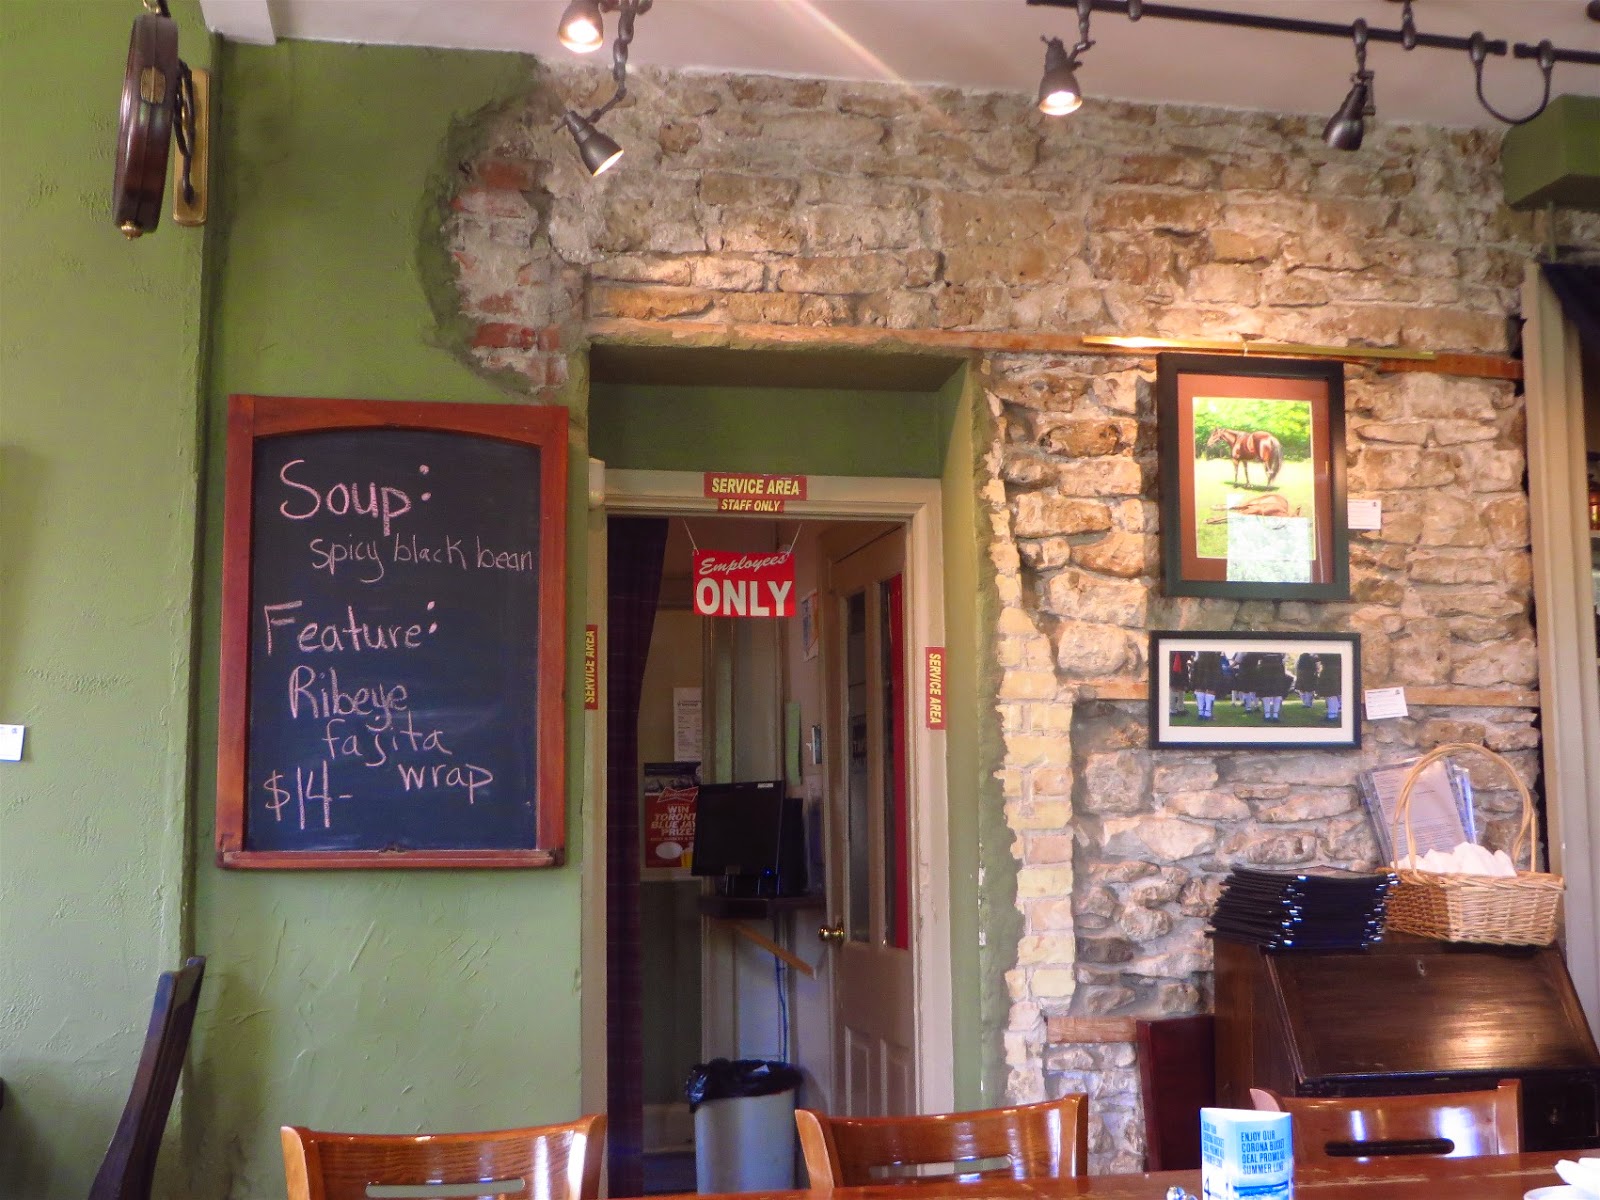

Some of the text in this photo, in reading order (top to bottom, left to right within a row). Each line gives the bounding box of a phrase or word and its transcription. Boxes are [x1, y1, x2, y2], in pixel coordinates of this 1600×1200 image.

[279, 458, 433, 536] Soup:
[711, 477, 800, 496] SERVICE AREA
[721, 498, 780, 512] STAFF ONLY
[393, 533, 469, 570] black
[476, 535, 534, 572] bean
[698, 553, 788, 576] Employees
[696, 577, 793, 617] ONLY
[263, 600, 439, 656] Feature:
[585, 630, 596, 704] SERVICE AREA
[287, 665, 408, 730] Ribeye
[929, 653, 942, 724] SERVICE AREA
[321, 711, 453, 767] fajita
[397, 763, 494, 804] wrap
[654, 813, 696, 821] TORONT
[668, 805, 690, 813] WIN
[650, 820, 679, 829] BLUE
[661, 828, 695, 836] PRIZE
[1241, 1129, 1276, 1142] ENJOY OUR
[1241, 1142, 1269, 1153] CORONA
[1241, 1153, 1258, 1164] DEAL
[1242, 1163, 1272, 1175] SUMMER
